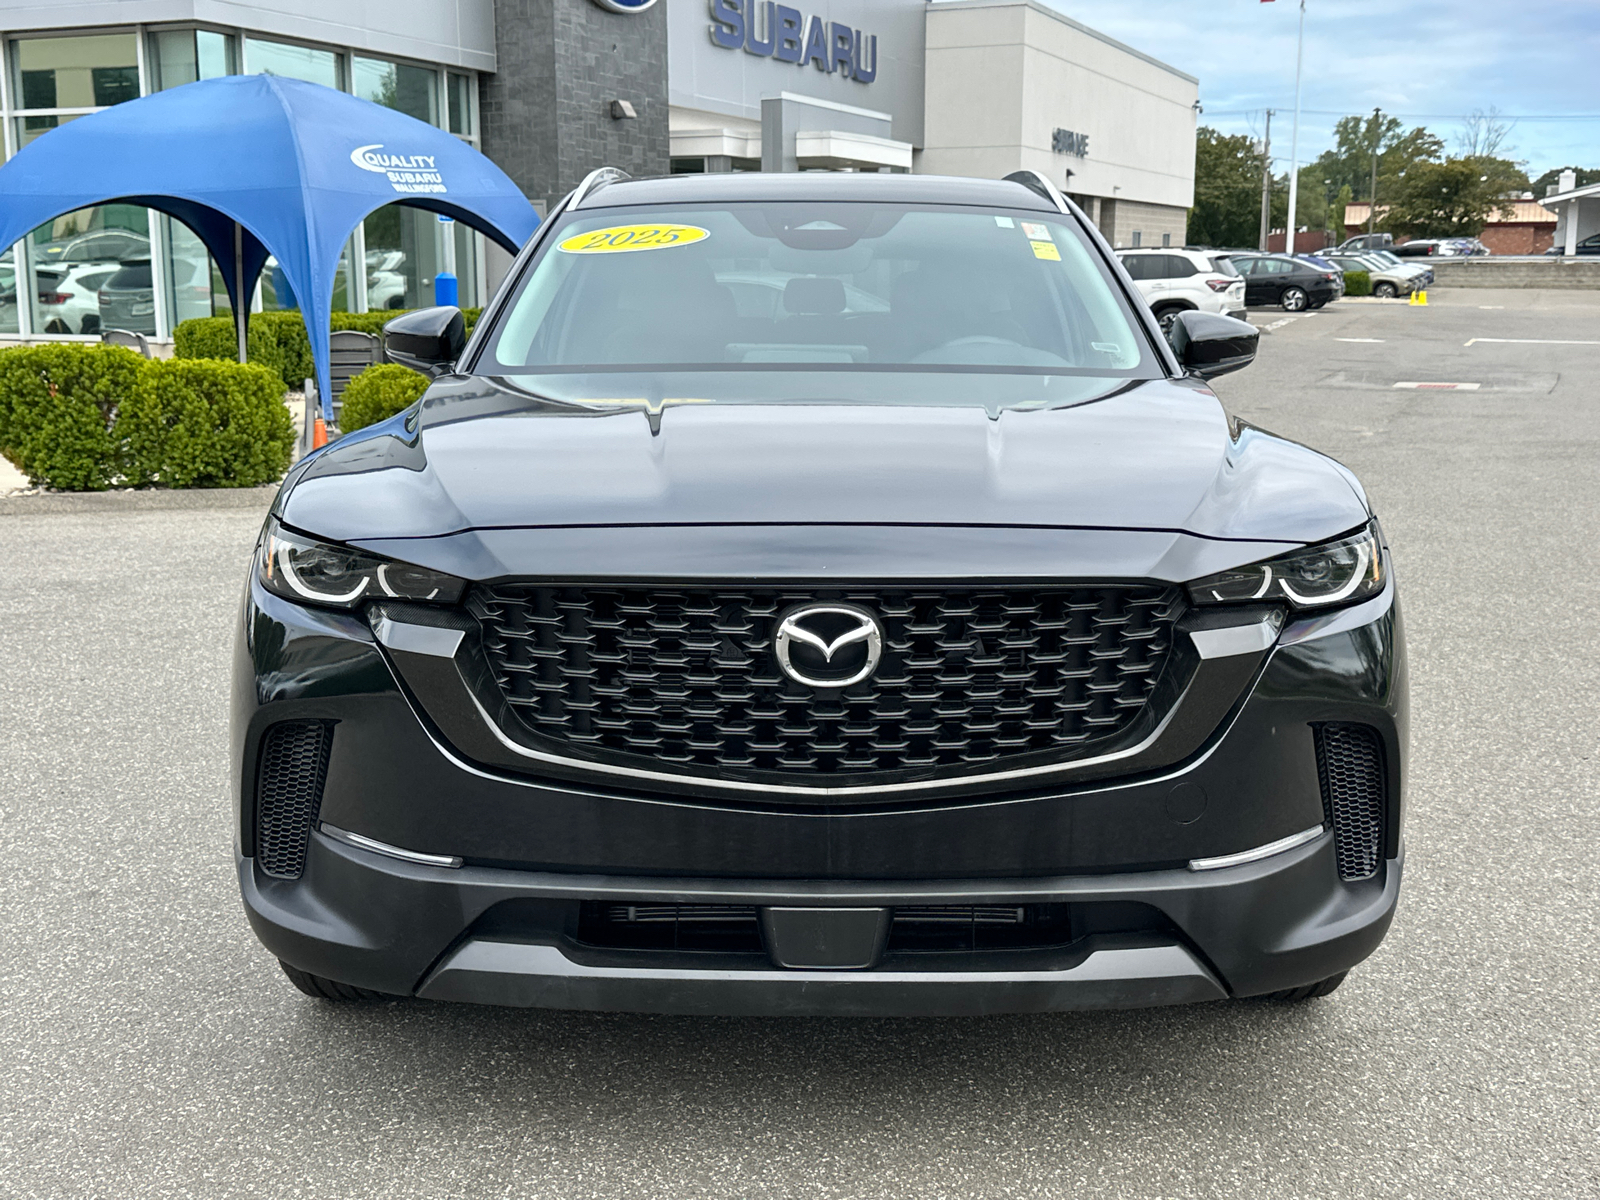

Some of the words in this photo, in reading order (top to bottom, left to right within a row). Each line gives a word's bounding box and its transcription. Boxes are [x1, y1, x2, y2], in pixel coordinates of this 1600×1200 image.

[709, 0, 877, 84] SUBARU
[364, 153, 435, 167] QUALITY
[386, 172, 442, 183] SUBARU
[581, 229, 687, 250] 2025
